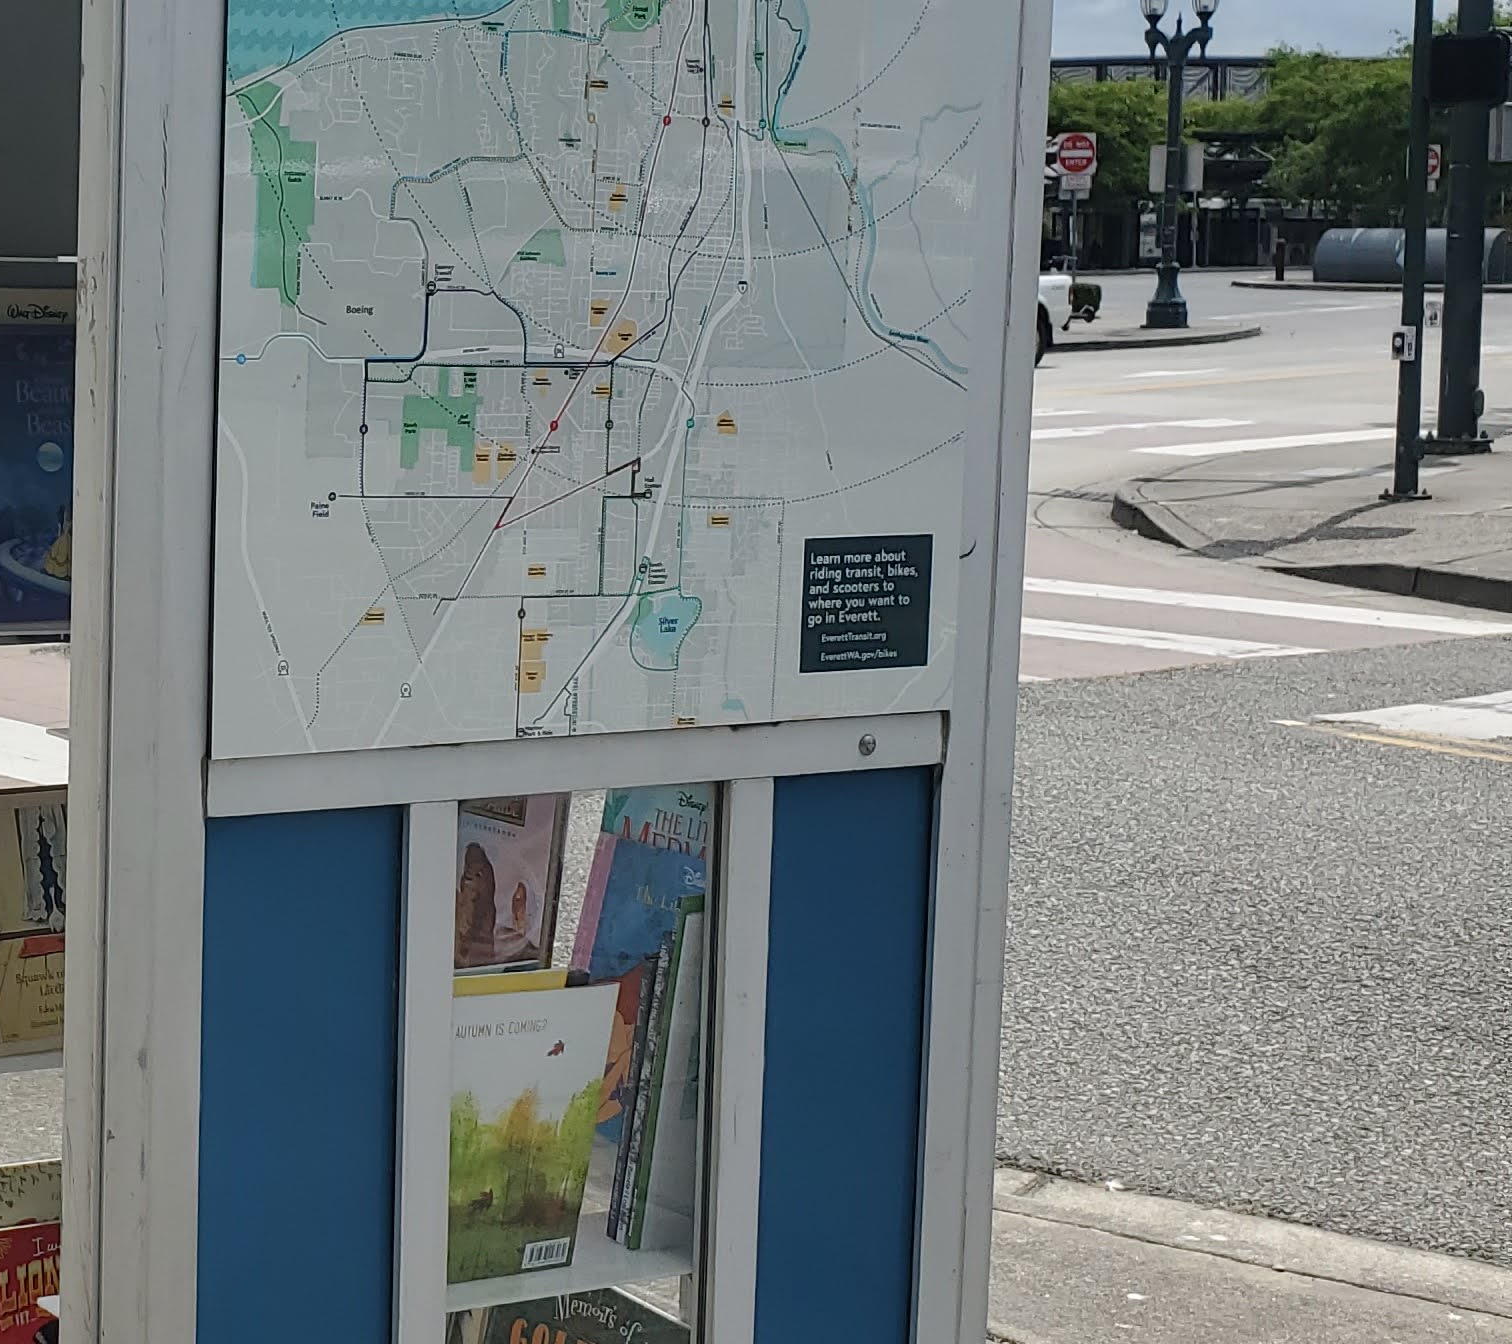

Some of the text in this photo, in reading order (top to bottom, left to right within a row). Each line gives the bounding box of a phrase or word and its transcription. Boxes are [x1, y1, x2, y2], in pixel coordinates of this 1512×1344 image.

[346, 306, 374, 315] Boeing
[811, 548, 906, 565] Learn more about
[810, 563, 919, 582] riding transit, bikes,
[809, 580, 895, 594] and scooters to
[808, 595, 910, 611] where you want to
[658, 617, 679, 626] Silver
[808, 610, 881, 628] go in Everett.
[660, 625, 676, 633] Lake
[821, 632, 887, 643] EverettTransit.org
[820, 649, 897, 662] EverettWA.gov/bikes
[655, 808, 683, 835] THE
[455, 1022, 492, 1041] AUTUMN
[495, 1022, 505, 1037] IS
[32, 1236, 44, 1257] I
[553, 1294, 618, 1329] Memoirs
